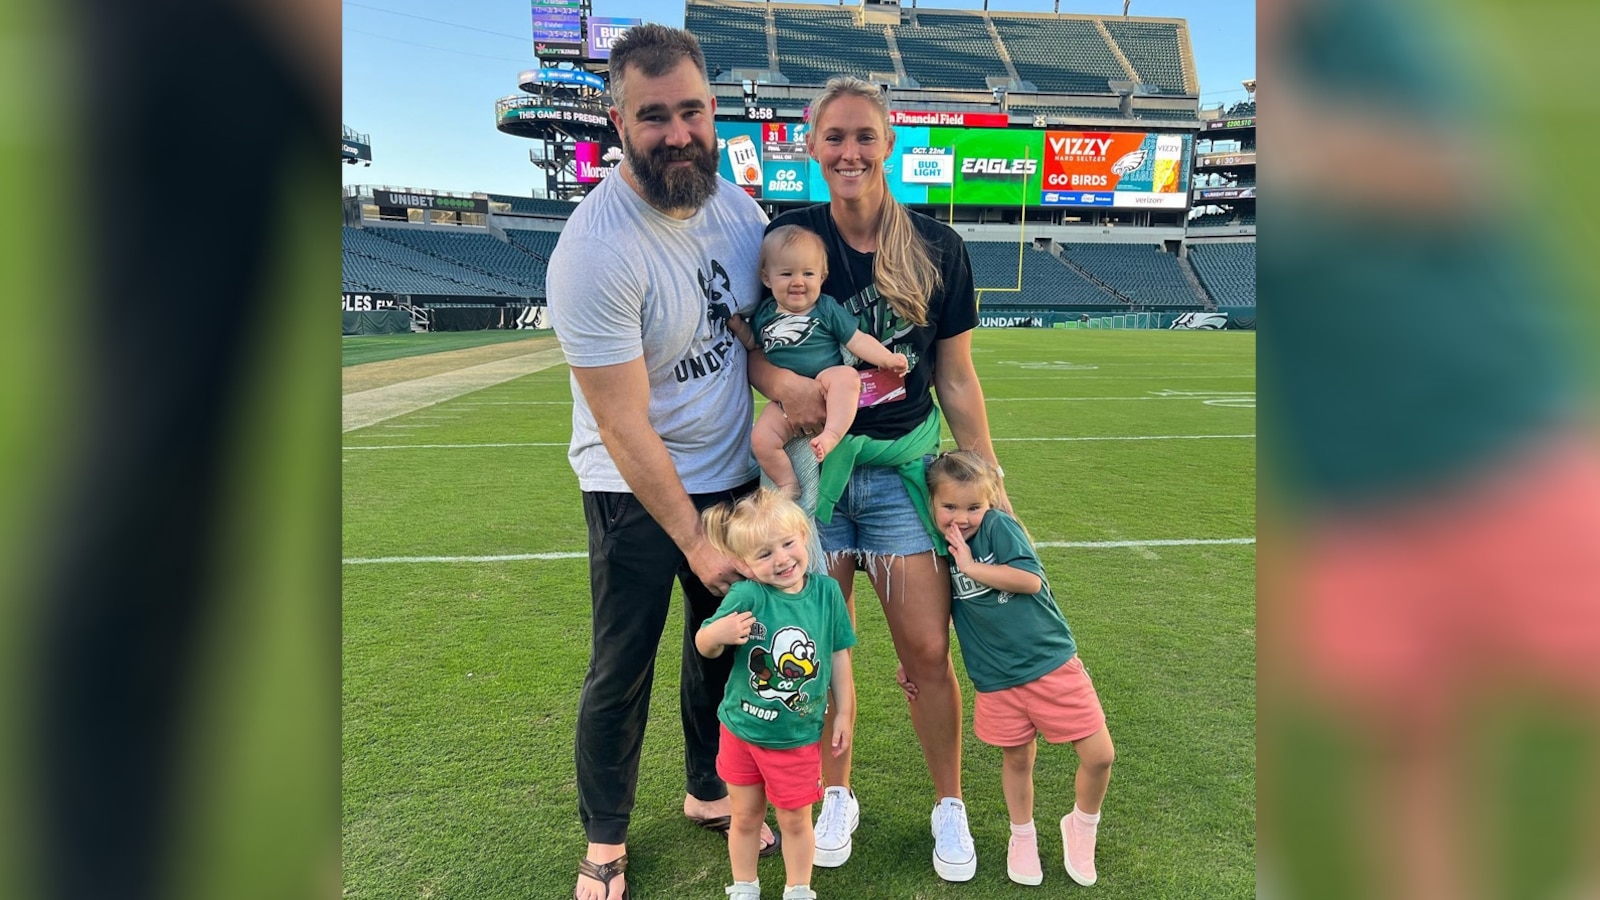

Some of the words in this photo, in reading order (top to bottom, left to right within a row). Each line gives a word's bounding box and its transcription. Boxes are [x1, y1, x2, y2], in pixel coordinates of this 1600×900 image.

[595, 37, 618, 49] LIG
[519, 111, 536, 119] THIS
[537, 111, 562, 119] GAME
[563, 112, 572, 120] IS
[748, 107, 773, 119] 3:58
[896, 112, 939, 124] Financial
[940, 113, 964, 124] Field
[768, 131, 779, 141] 31
[793, 132, 805, 142] 34
[1049, 137, 1112, 156] VIZZY
[961, 158, 1037, 174] EAGLES
[775, 169, 797, 181] GO
[1048, 173, 1068, 185] GO
[1071, 174, 1108, 186] BIRDS
[768, 180, 804, 192] BIRDS
[390, 193, 434, 207] UNIBET
[1136, 196, 1161, 204] verizon
[674, 341, 734, 383] UNDE
[742, 702, 779, 721] SWOOP
